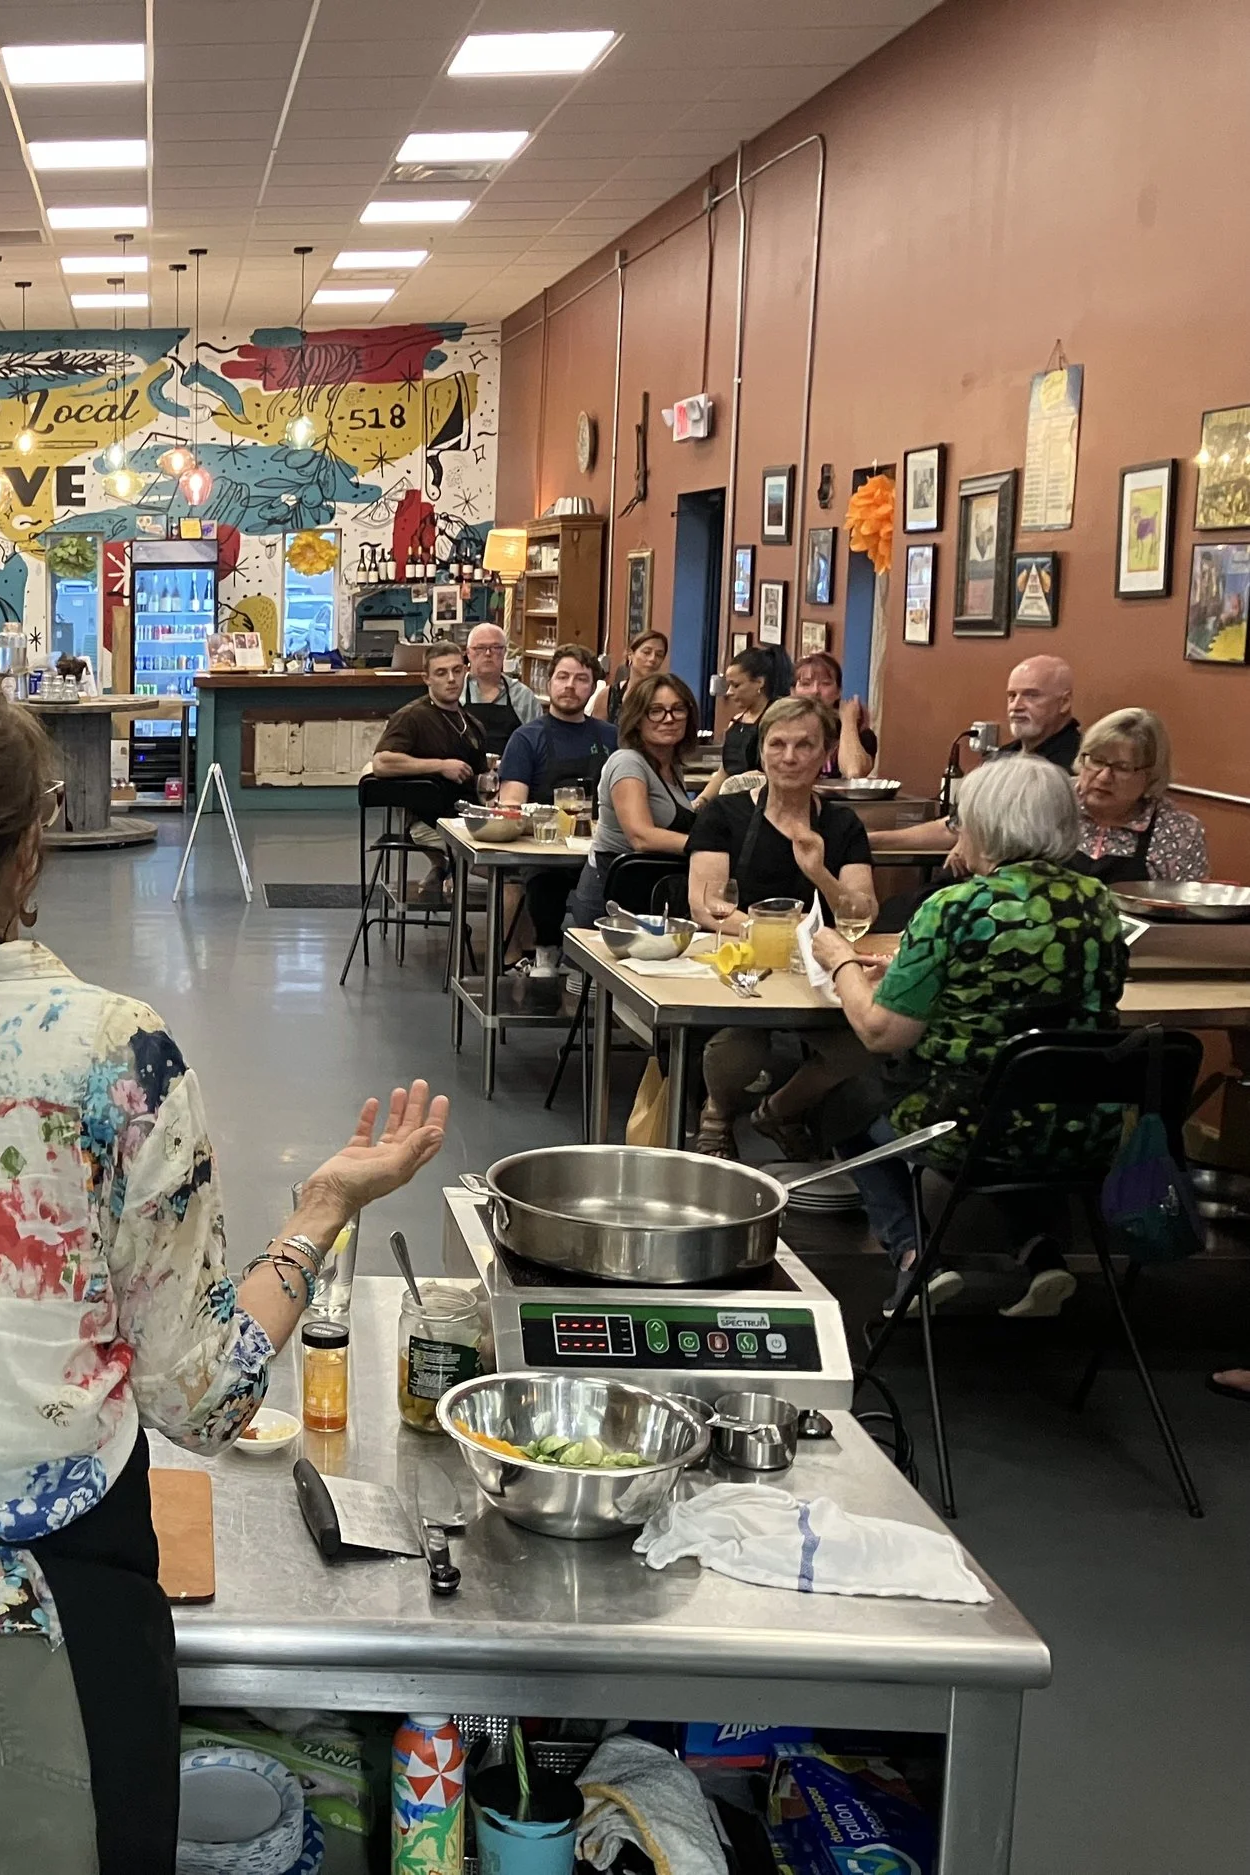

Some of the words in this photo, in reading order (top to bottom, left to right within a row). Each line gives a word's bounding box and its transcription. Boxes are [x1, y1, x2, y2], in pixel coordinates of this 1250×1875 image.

[21, 388, 140, 434] Local
[348, 404, 406, 430] 518
[721, 1318, 768, 1328] SPECTRUM
[717, 1723, 781, 1742] Zipo
[303, 1743, 362, 1771] VINYL
[834, 1803, 870, 1841] gallon
